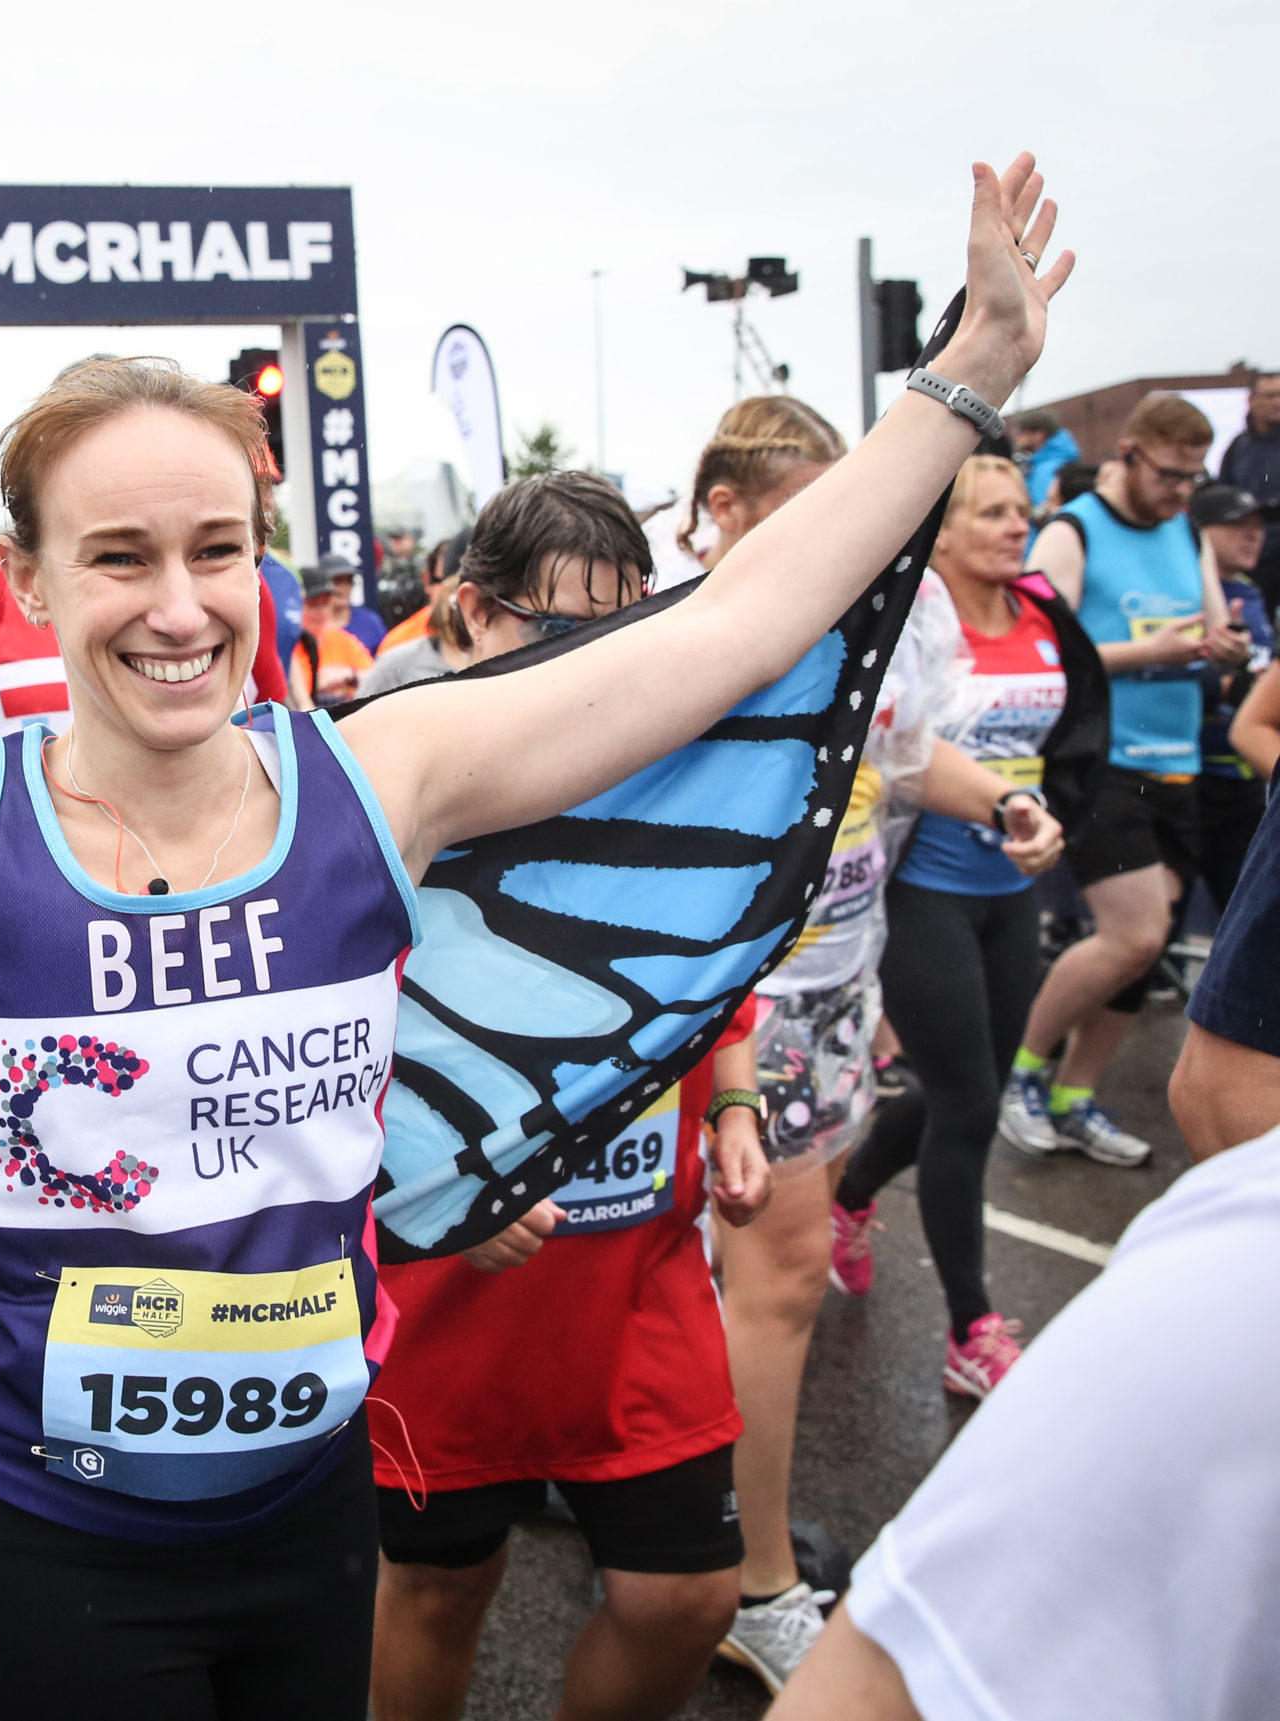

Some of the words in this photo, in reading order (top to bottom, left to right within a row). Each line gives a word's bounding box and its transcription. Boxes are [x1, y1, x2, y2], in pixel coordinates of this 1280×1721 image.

[87, 898, 284, 1014] BEEF
[186, 1017, 372, 1086] CANCER
[190, 1055, 387, 1131] RESEARCH
[192, 1134, 258, 1180] UK
[560, 1132, 663, 1188] 469
[567, 1193, 656, 1223] CAROLINE
[95, 1302, 128, 1317] wiggle
[136, 1295, 179, 1312] MCR
[142, 1311, 172, 1320] HALF
[211, 1291, 338, 1323] #MCRHALF
[80, 1372, 329, 1436] 15989
